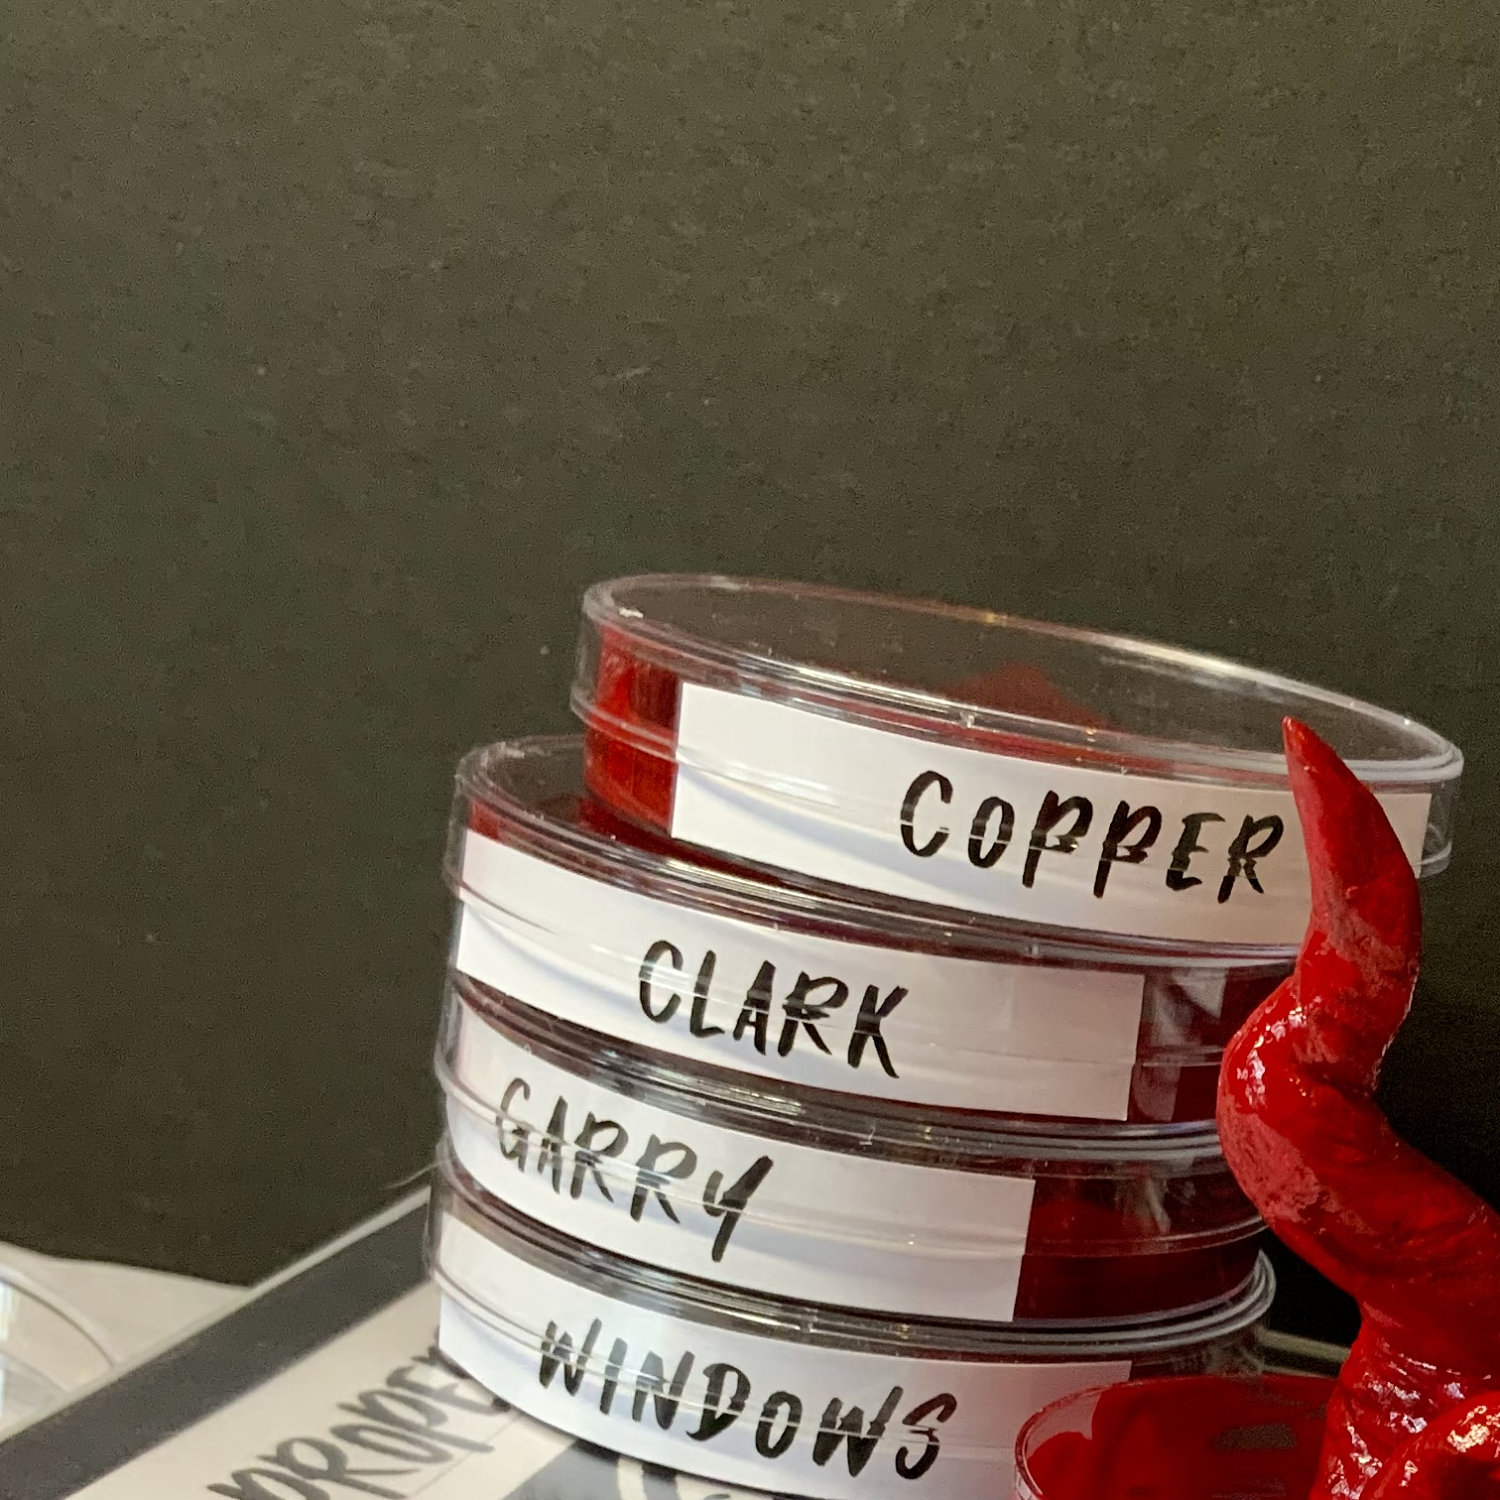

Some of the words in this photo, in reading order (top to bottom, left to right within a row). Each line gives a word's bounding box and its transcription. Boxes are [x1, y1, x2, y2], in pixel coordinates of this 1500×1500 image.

[898, 768, 1285, 904] COPPER
[636, 938, 911, 1079] CLARK
[494, 1076, 774, 1262] GARRY
[538, 1316, 960, 1480] WINDOWS
